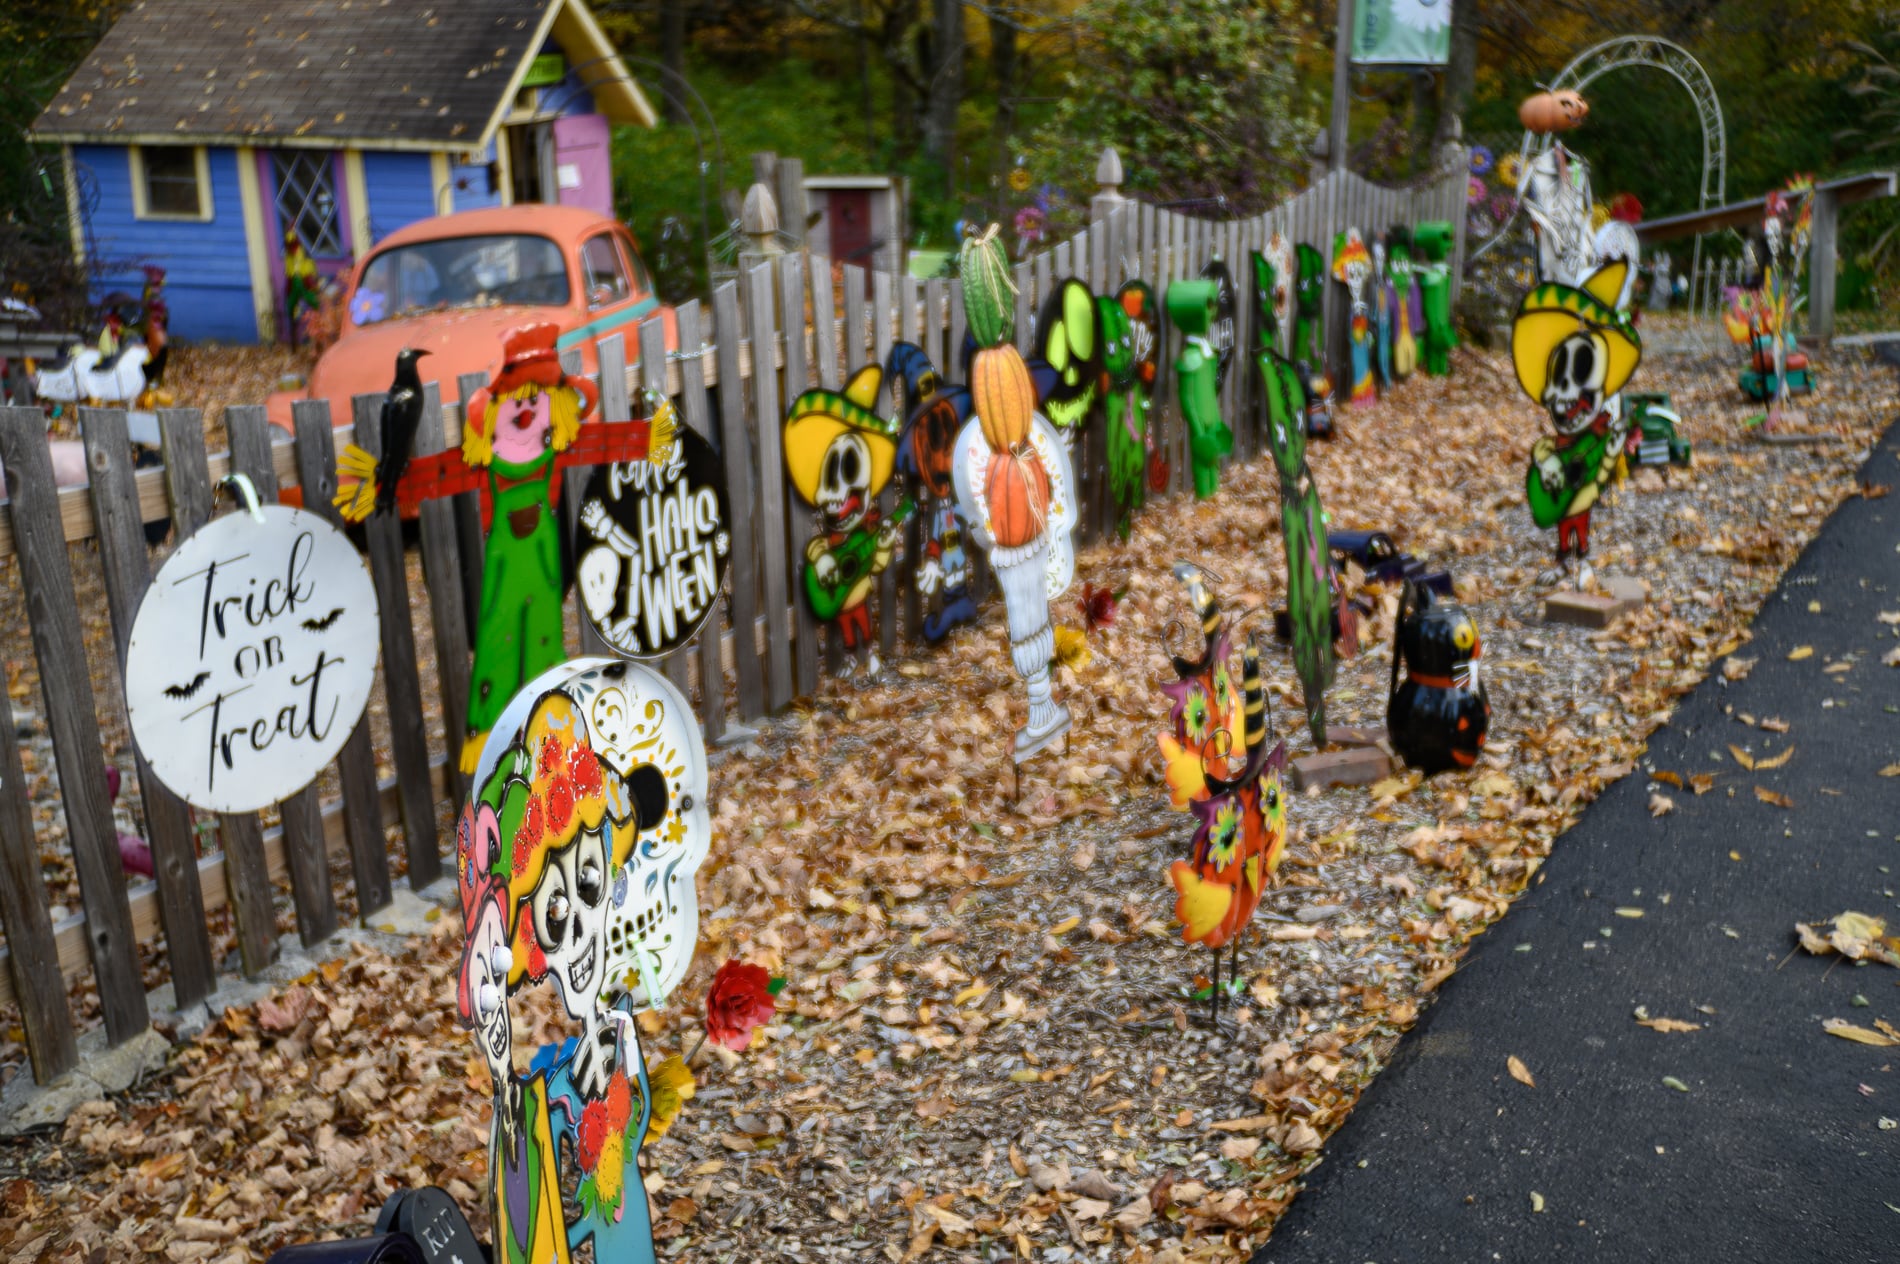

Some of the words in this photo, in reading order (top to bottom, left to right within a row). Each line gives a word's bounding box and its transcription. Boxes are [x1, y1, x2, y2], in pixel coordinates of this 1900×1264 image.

[172, 530, 316, 661] Trick
[641, 541, 718, 649] WEEN
[180, 651, 345, 792] Treat
